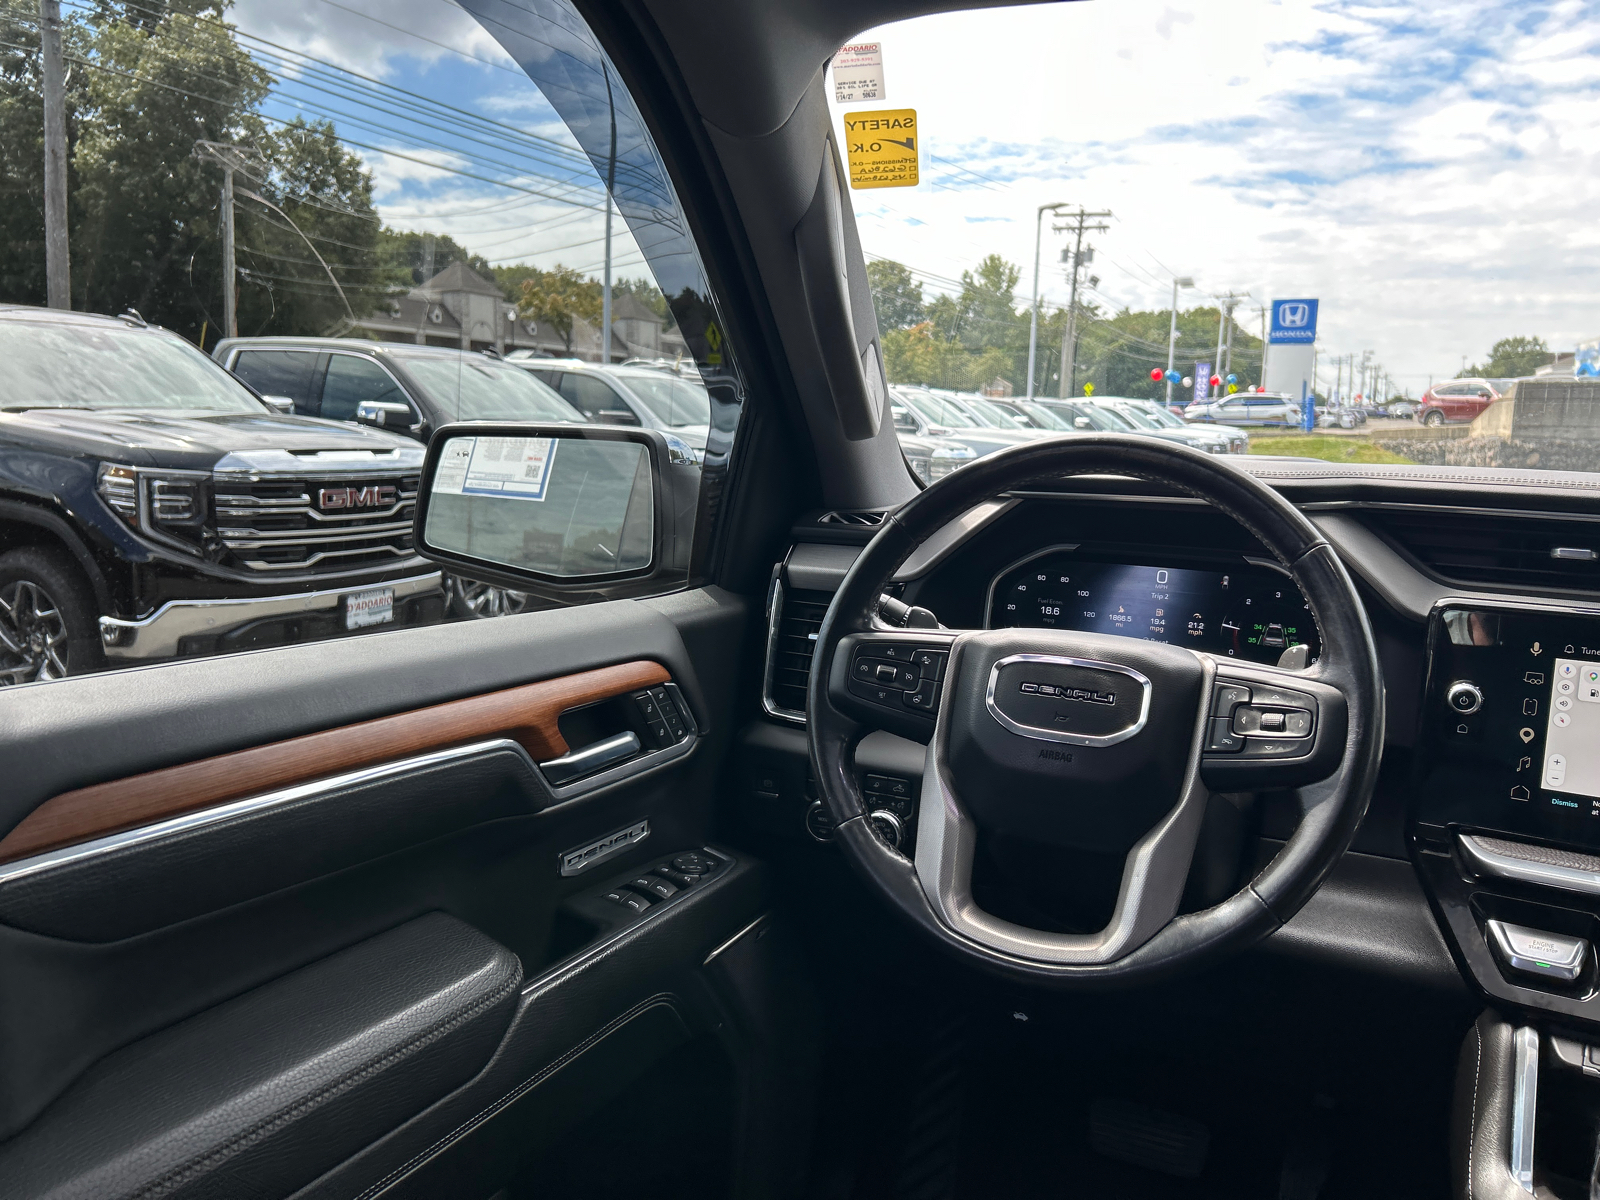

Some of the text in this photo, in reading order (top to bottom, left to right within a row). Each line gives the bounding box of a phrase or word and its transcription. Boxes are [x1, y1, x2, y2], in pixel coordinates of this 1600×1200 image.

[1271, 330, 1314, 339] HONDA
[319, 486, 397, 509] GMC
[347, 595, 392, 613] D'ADDARIO
[1040, 606, 1060, 615] 18.6
[1149, 625, 1164, 634] mpg
[1187, 621, 1205, 630] 21.2
[1021, 683, 1116, 705] DENALI
[1039, 749, 1073, 762] AIRBAG
[1551, 798, 1579, 808] Dismiss
[567, 824, 645, 867] DENALI
[1532, 940, 1555, 949] ENGINE
